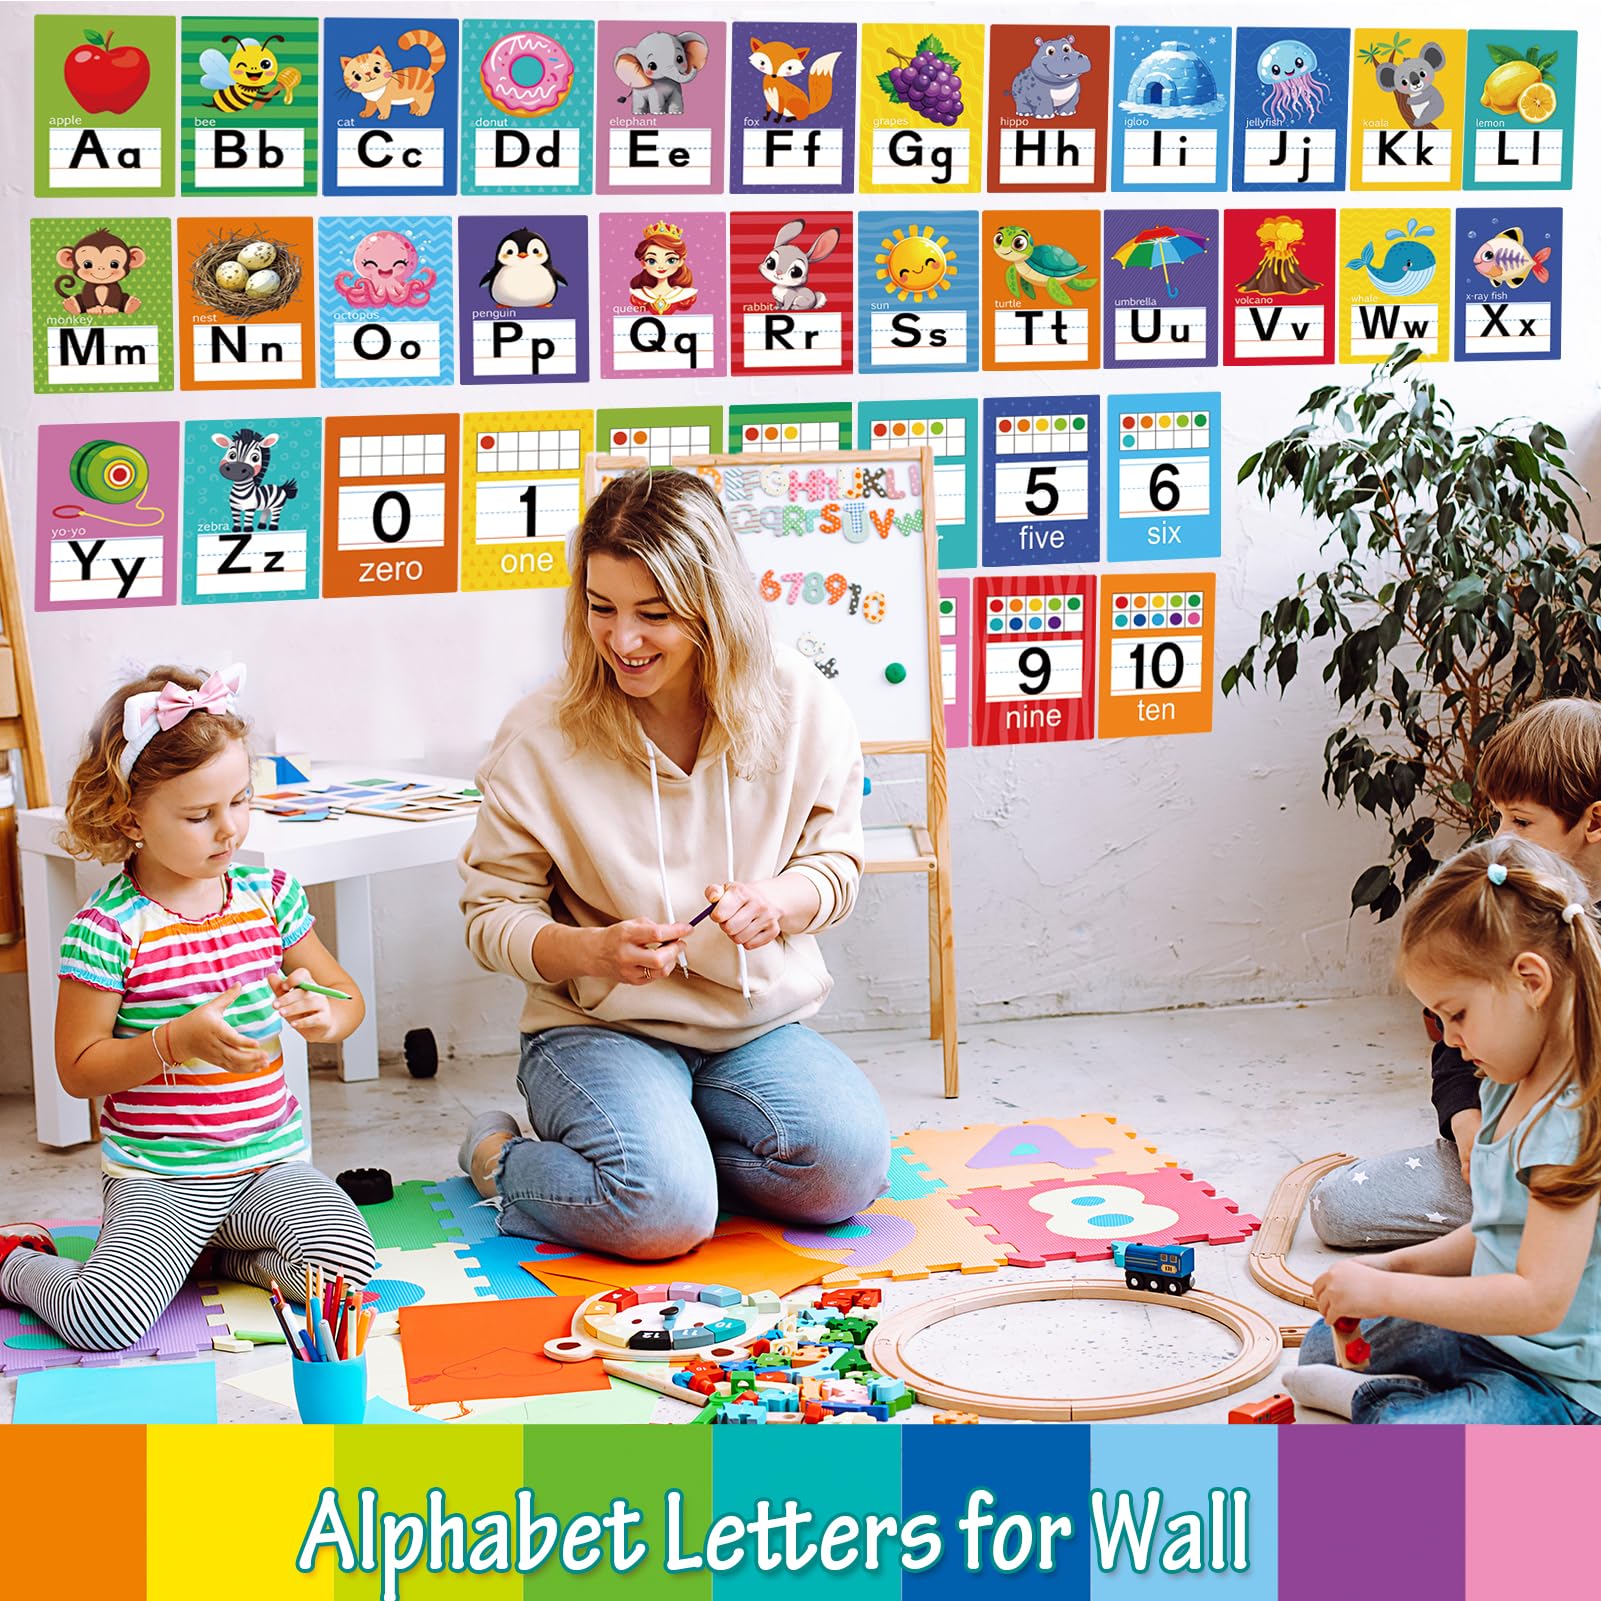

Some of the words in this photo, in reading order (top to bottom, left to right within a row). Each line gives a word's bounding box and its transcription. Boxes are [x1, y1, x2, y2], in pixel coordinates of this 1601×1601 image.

[49, 115, 82, 127] apple
[194, 117, 216, 127] bee
[337, 117, 355, 127] cat
[475, 117, 508, 127] donut
[610, 116, 656, 128] elephant
[744, 116, 760, 127] fox
[873, 116, 909, 129] grapes
[1000, 116, 1029, 128] hippo
[1124, 117, 1149, 128] igloo
[1246, 117, 1282, 128] jellyfish
[1363, 118, 1389, 127] koala
[1476, 118, 1505, 127] lemon
[995, 298, 1022, 308] turtle
[1115, 296, 1157, 306] umbrella
[1235, 295, 1273, 305] volcano
[1352, 294, 1378, 303] whale
[1465, 293, 1489, 303] x-ray
[1490, 292, 1508, 301] fish
[613, 304, 648, 315] queen
[743, 302, 774, 312] rabbit
[871, 301, 890, 310] sun
[193, 312, 217, 323] nest
[334, 310, 380, 322] octopus
[472, 308, 516, 320] penguin
[47, 314, 93, 327] monkey
[1025, 466, 1059, 516] 5
[1149, 463, 1180, 512] 6
[372, 490, 411, 544] 0
[519, 485, 537, 538] 1
[51, 526, 87, 538] yo-yo
[197, 522, 229, 532] zebra
[1147, 520, 1181, 545] six
[1019, 525, 1065, 550] five
[501, 552, 553, 573] one
[359, 560, 423, 582] zero
[1018, 646, 1052, 696] 9
[1129, 641, 1184, 690] 10
[1137, 700, 1175, 721] ten
[1006, 705, 1061, 729] nine
[1028, 1185, 1179, 1240] 8
